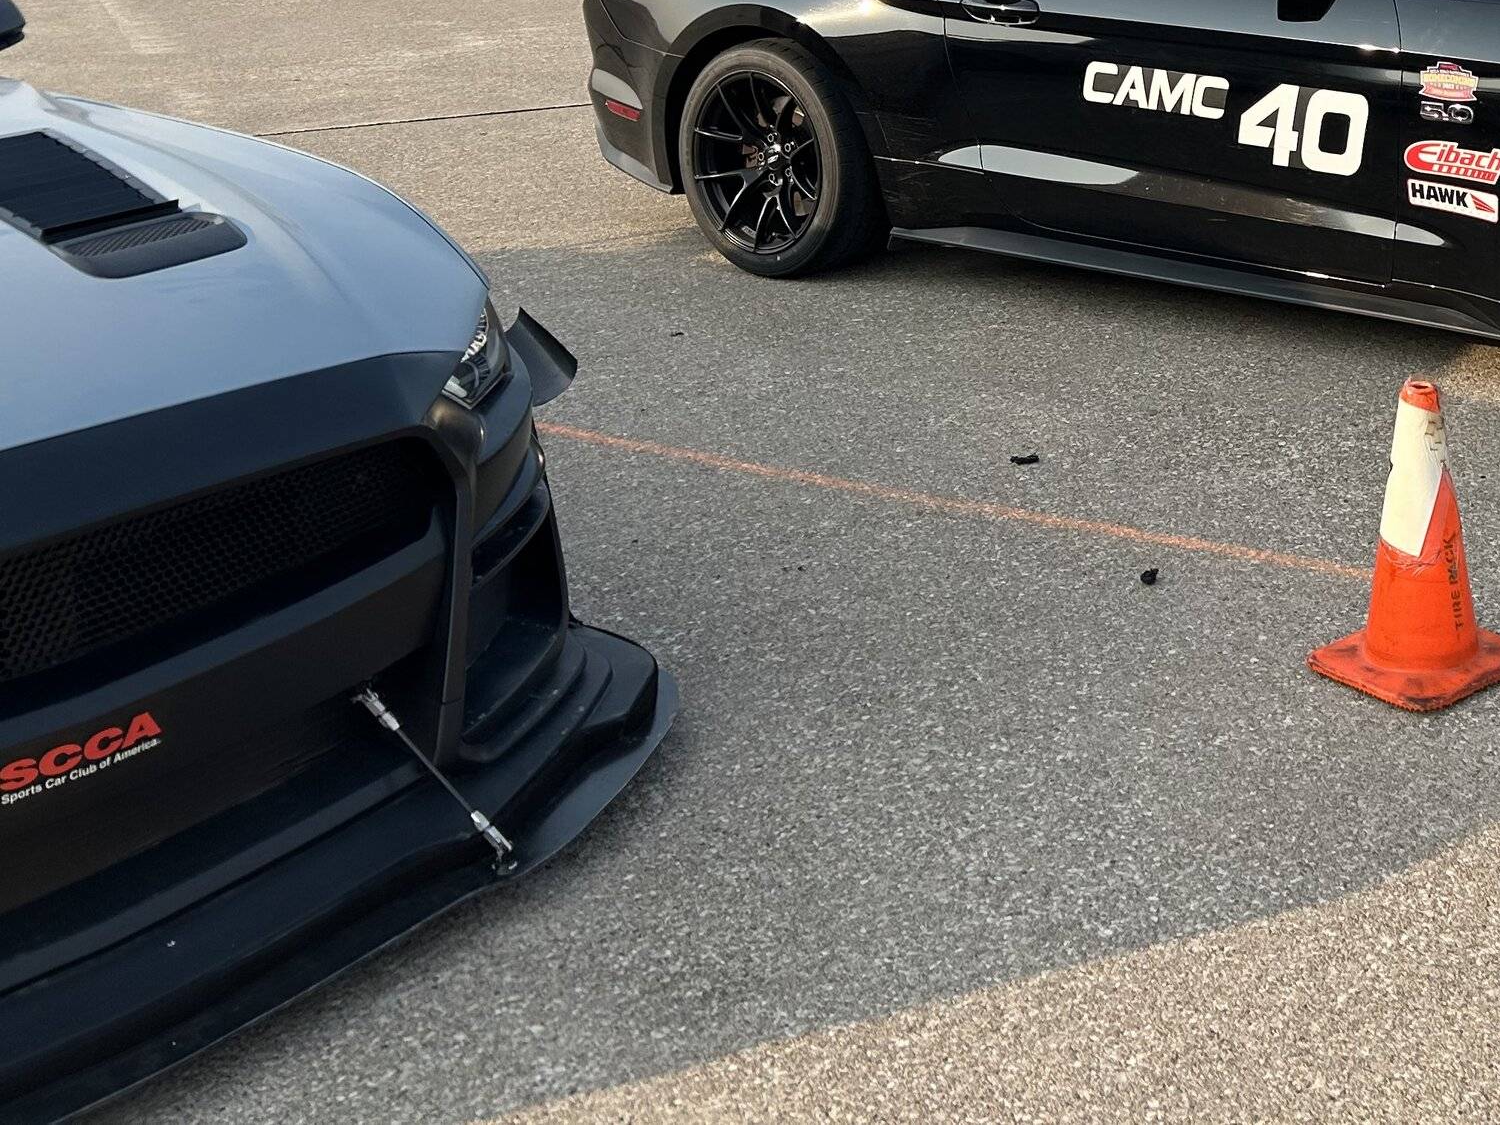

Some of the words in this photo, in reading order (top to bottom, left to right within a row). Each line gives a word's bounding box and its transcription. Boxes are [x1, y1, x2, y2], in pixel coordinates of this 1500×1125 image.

[1082, 60, 1231, 120] CAMC
[1237, 83, 1370, 176] 40
[1411, 182, 1469, 209] HAWK
[0, 711, 162, 791] SCCA
[1, 783, 43, 805] Sports
[45, 775, 66, 790] Car
[69, 763, 98, 782] Club
[99, 756, 111, 770] of
